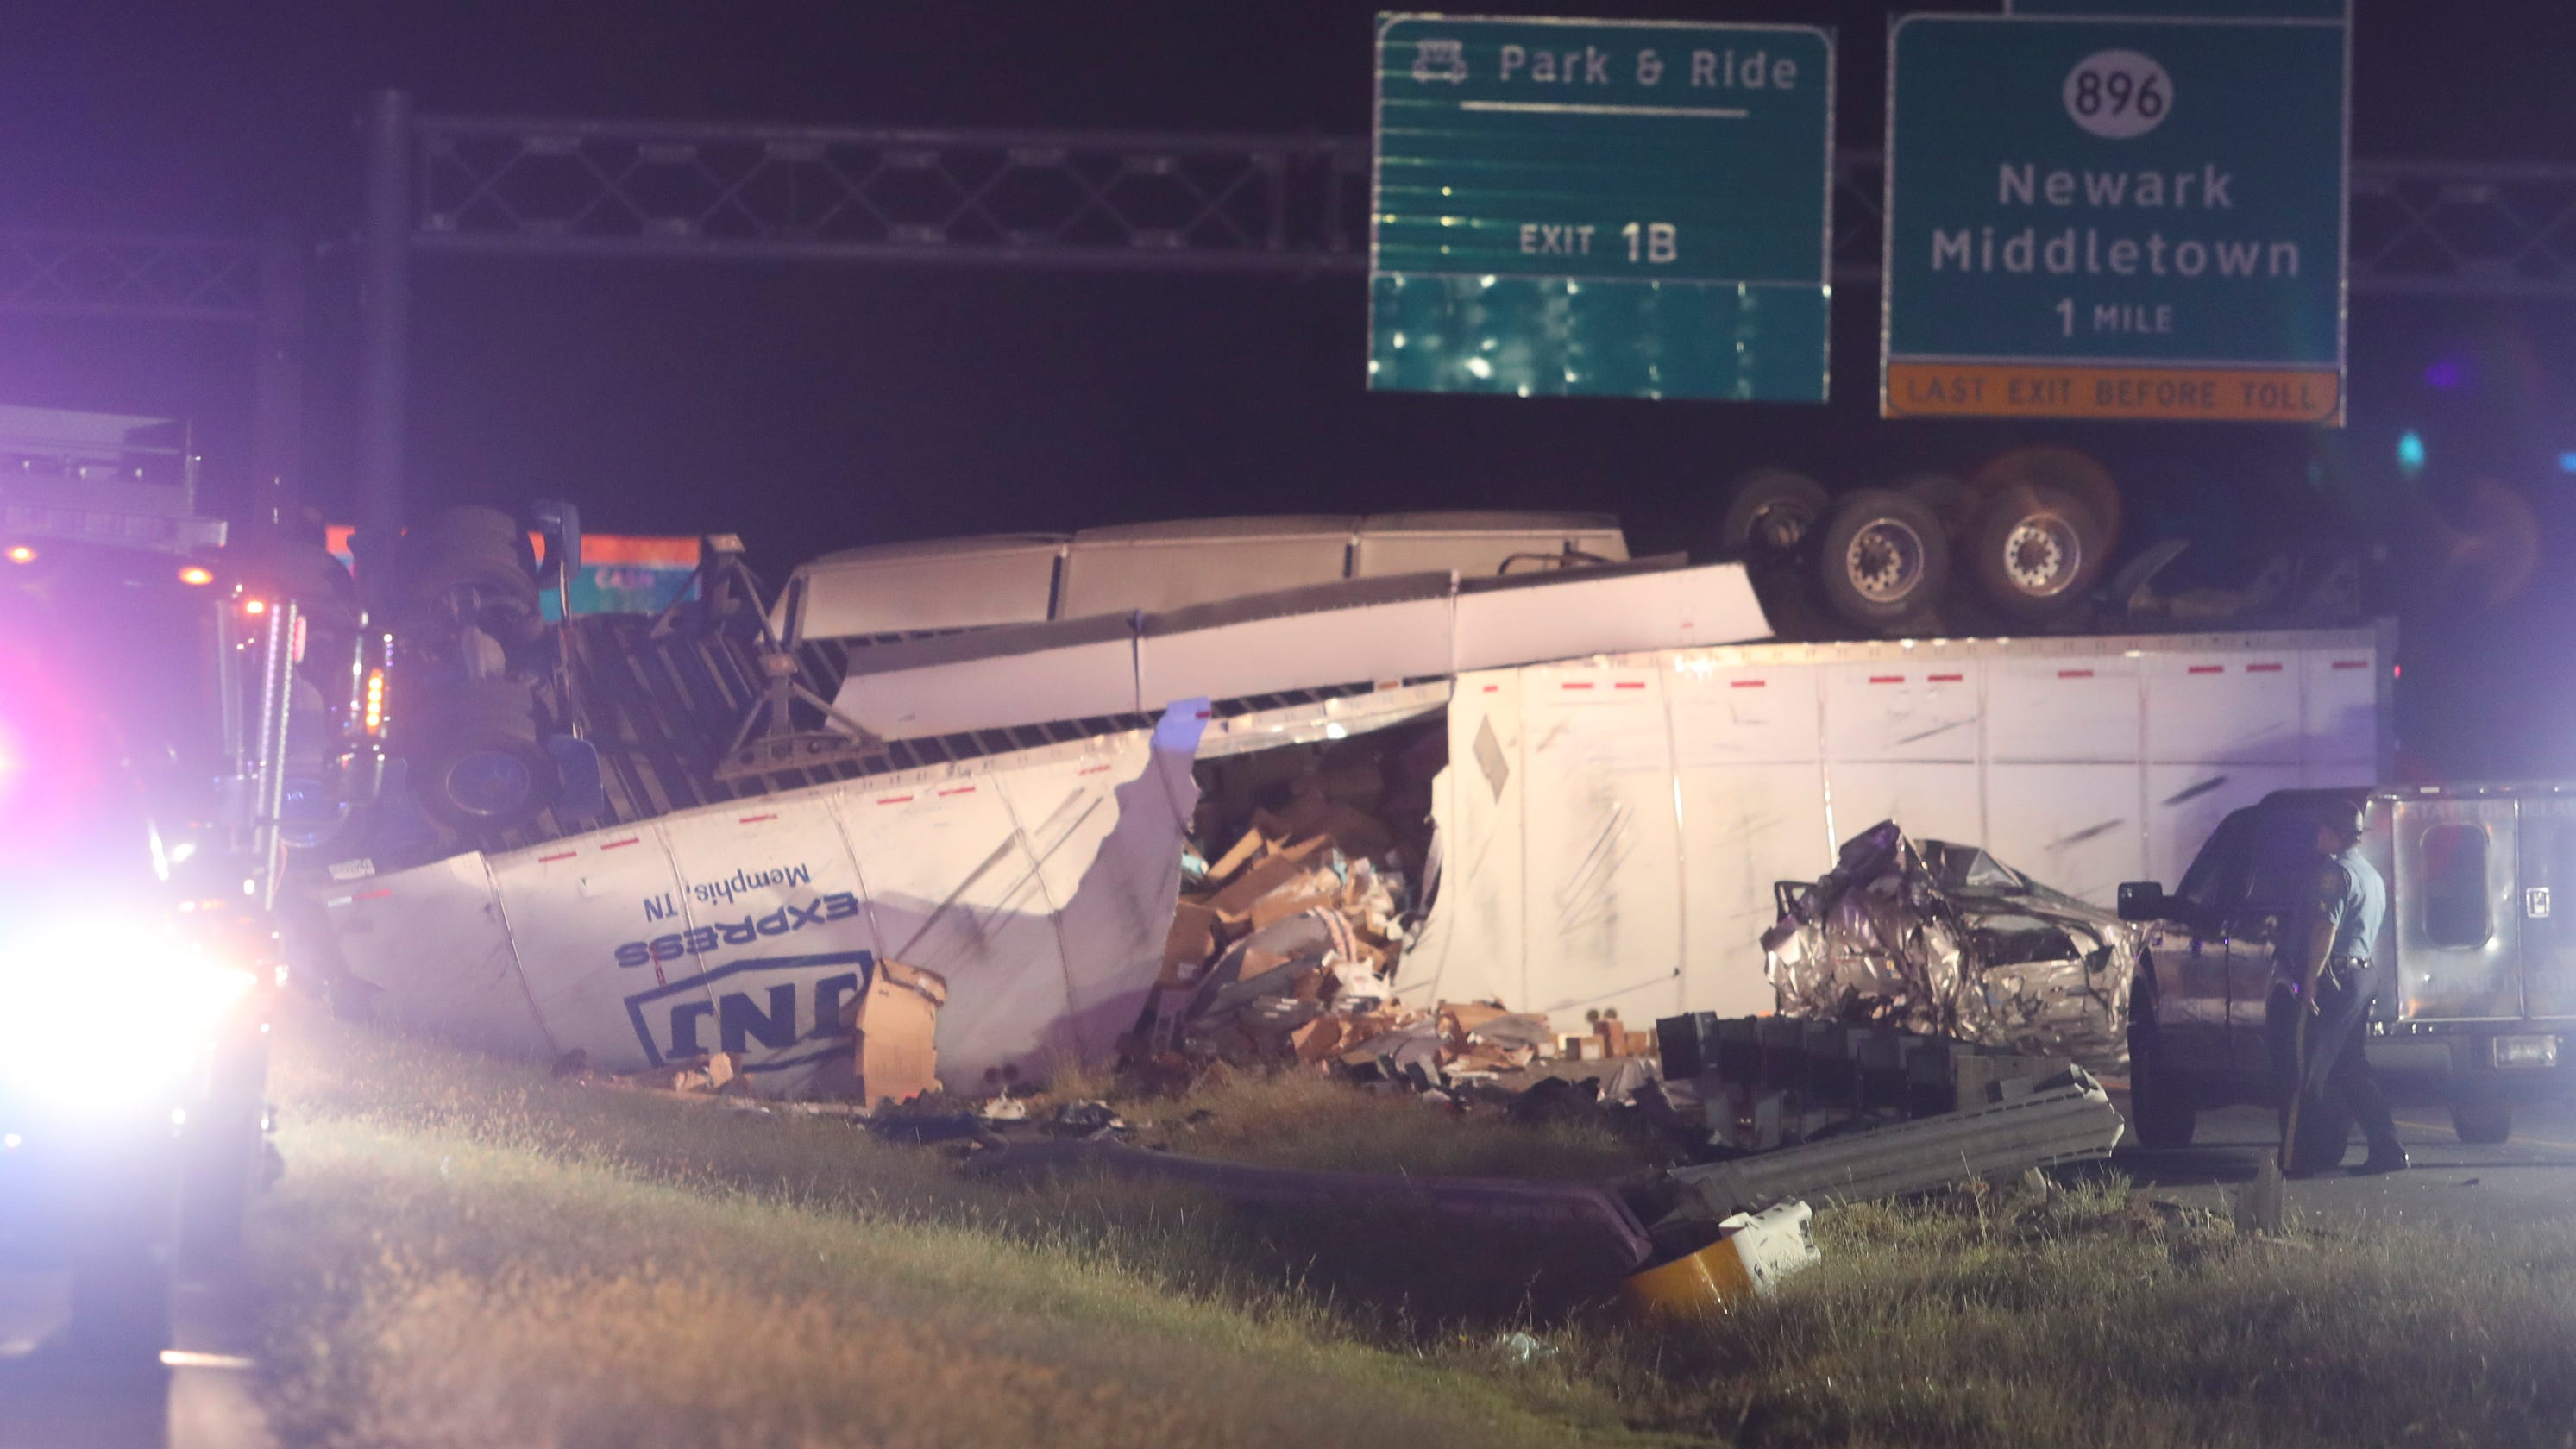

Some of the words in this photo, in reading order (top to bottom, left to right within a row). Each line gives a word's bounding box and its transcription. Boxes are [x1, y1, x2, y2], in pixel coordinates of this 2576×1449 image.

[1499, 44, 1609, 85] Park
[1637, 49, 1665, 85] &
[1691, 48, 1797, 88] Ride
[2075, 70, 2164, 119] 896
[1999, 163, 2234, 208] Newark
[1520, 223, 1595, 255] EXIT
[1622, 222, 1678, 263] 1B
[1931, 226, 2300, 277] Middletown
[2056, 298, 2075, 336] 1
[2093, 304, 2174, 335] MILE
[1907, 376, 1984, 404] LAST
[2007, 379, 2073, 405] EXIT
[2095, 380, 2216, 409] BEFORE
[2243, 384, 2316, 411] TOLL
[686, 863, 811, 906] Memphis,
[644, 892, 678, 923] TN
[614, 892, 858, 968] EXPRESS
[668, 973, 859, 1059] JNJ
